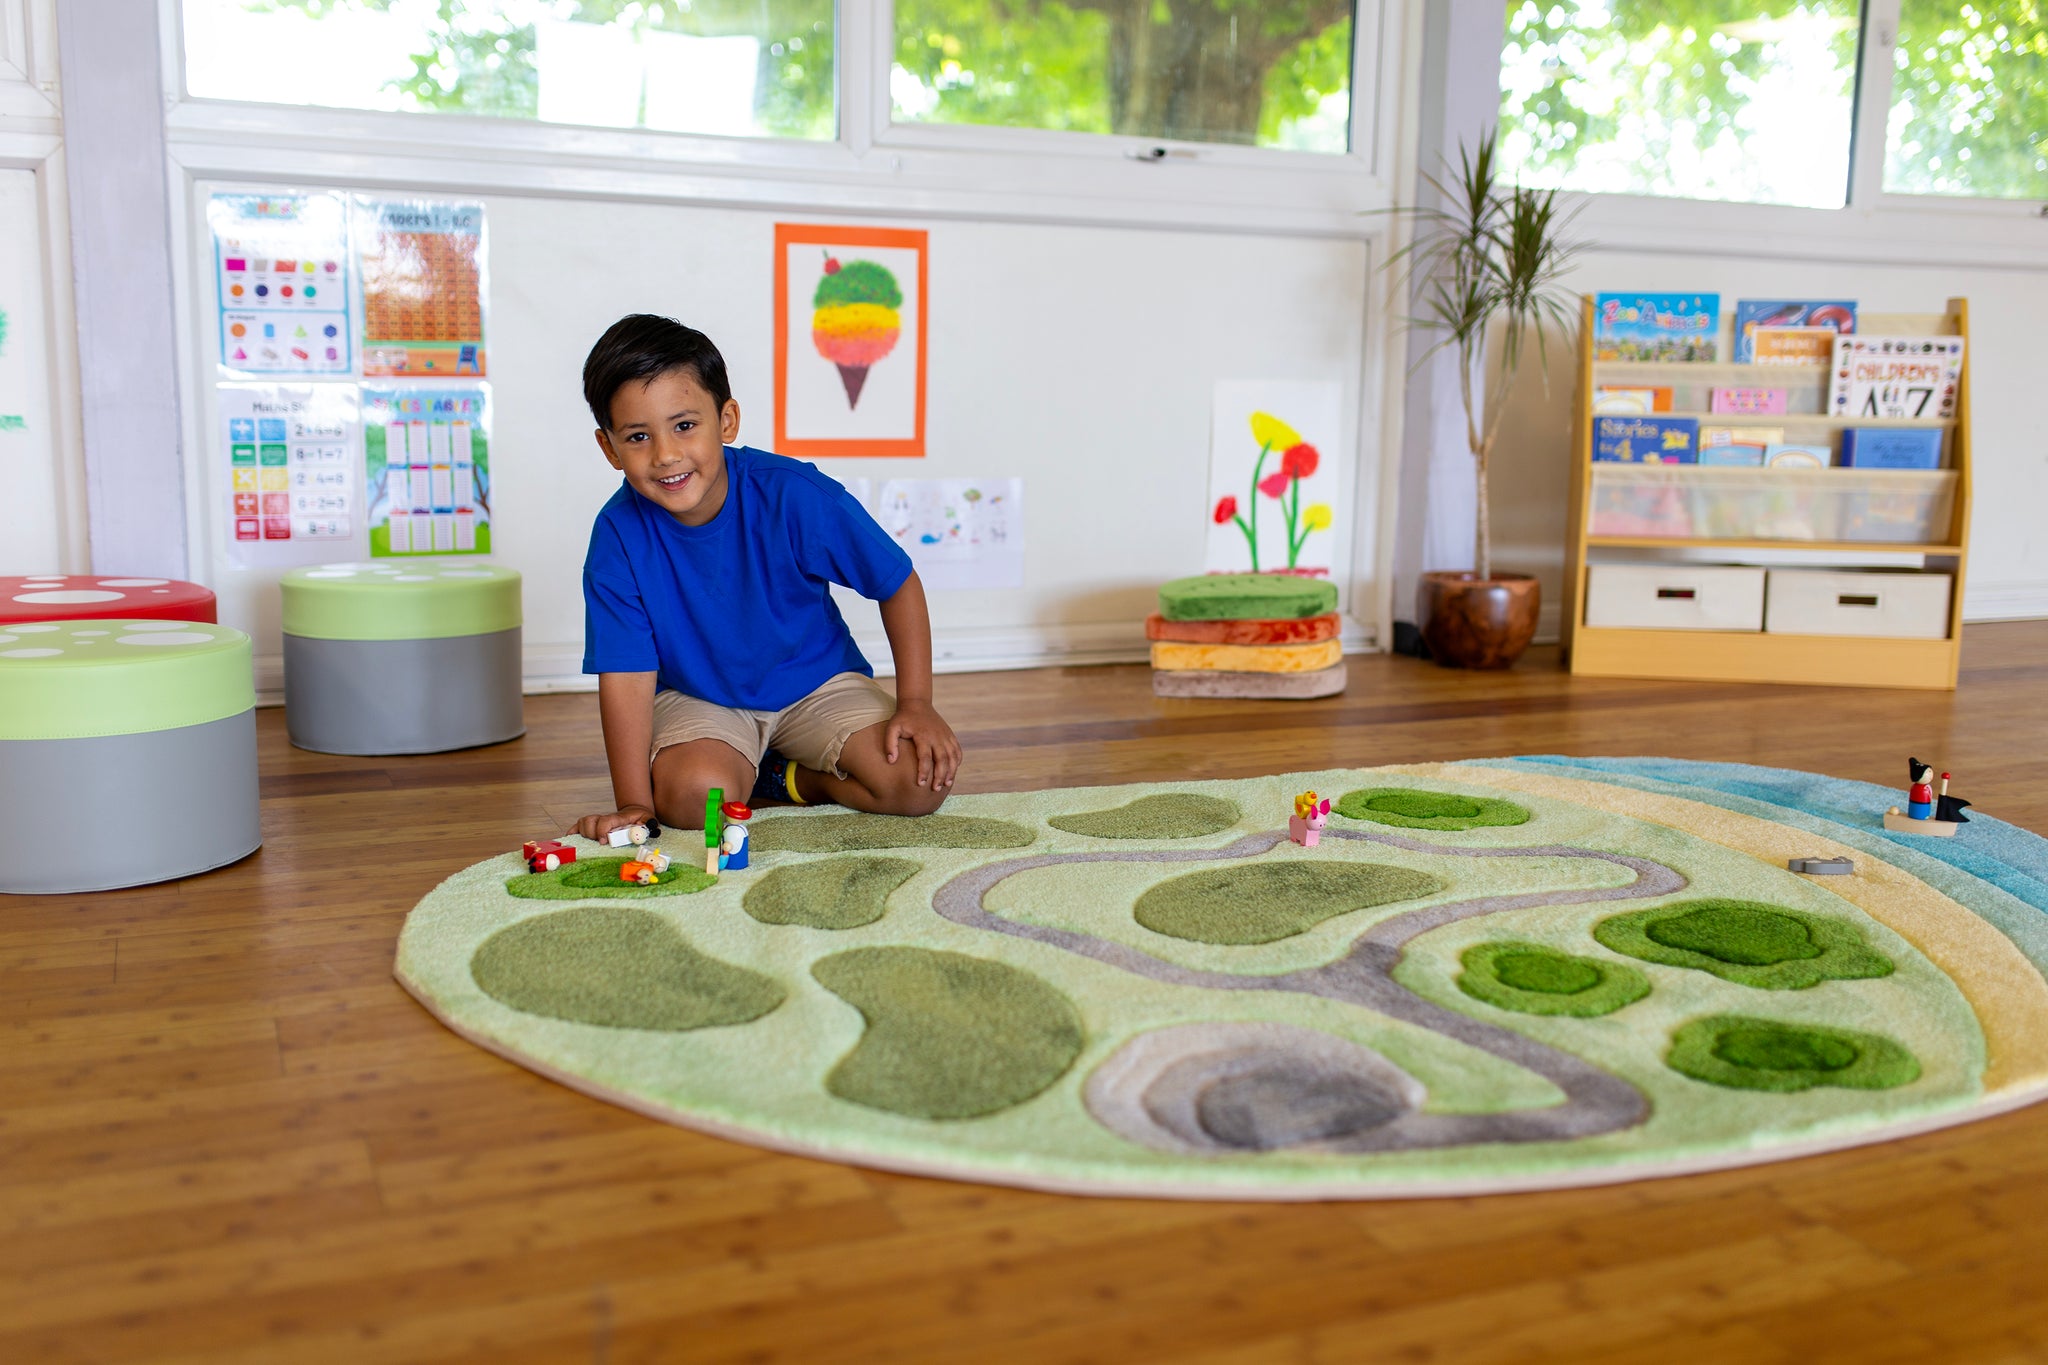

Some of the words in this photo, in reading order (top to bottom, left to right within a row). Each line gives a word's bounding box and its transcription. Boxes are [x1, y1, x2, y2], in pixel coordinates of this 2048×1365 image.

[1602, 299, 1639, 324] Zoo
[1641, 301, 1710, 331] Animals
[1600, 418, 1658, 439] Stories
